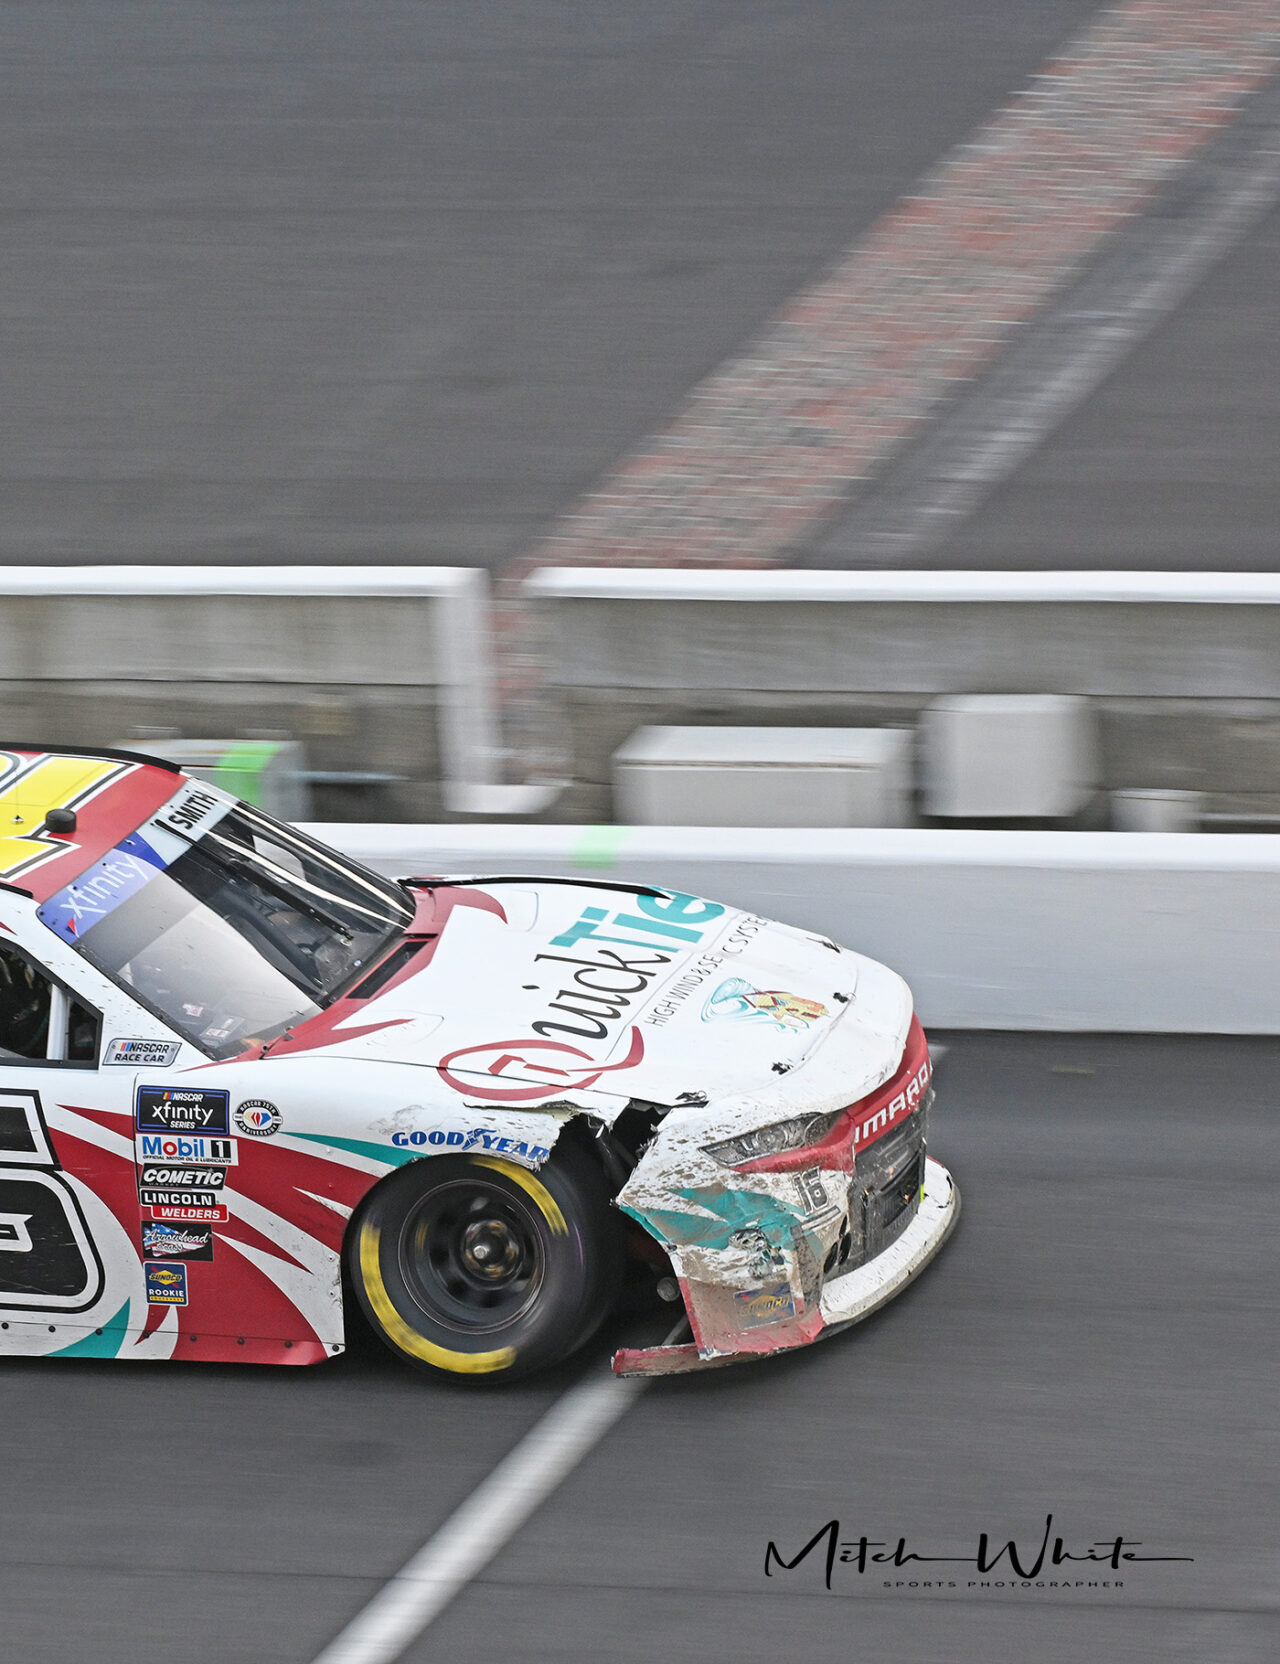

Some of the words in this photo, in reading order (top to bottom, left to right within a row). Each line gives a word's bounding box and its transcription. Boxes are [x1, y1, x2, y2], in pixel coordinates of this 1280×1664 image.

[168, 789, 219, 830] SMITH
[59, 854, 150, 919] xfinity
[644, 997, 680, 1027] HIGH
[669, 974, 704, 1001] WIND
[130, 1043, 170, 1054] NASCAR
[114, 1053, 140, 1062] RACE
[144, 1054, 166, 1063] CAR
[172, 1092, 204, 1103] NASCAR
[152, 1102, 214, 1126] xfinity
[170, 1120, 196, 1129] SERIES
[142, 1136, 205, 1157] Mobil
[143, 1168, 224, 1186] COMETIC
[144, 1192, 213, 1206] LINCOLN
[161, 1207, 221, 1219] WELDERS
[149, 1273, 183, 1282] SUNOCO
[149, 1288, 184, 1297] ROOKIE
